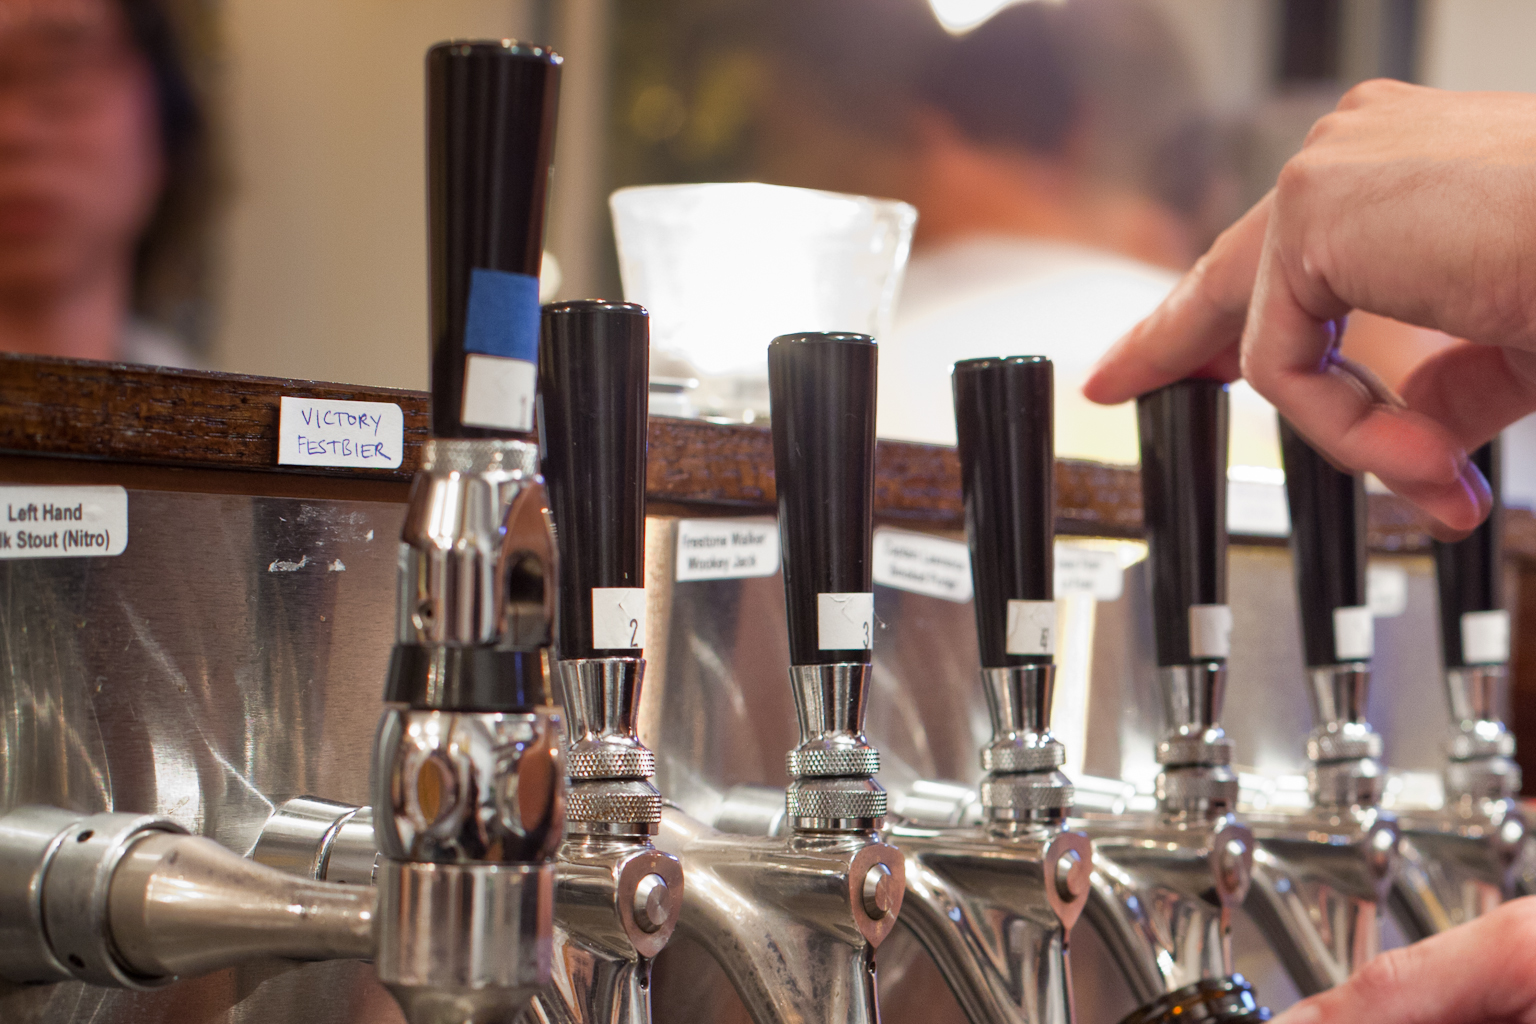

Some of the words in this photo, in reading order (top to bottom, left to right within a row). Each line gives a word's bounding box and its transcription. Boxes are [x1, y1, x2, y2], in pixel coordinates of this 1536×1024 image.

[301, 408, 382, 435] VICTORY
[298, 436, 391, 460] FESTBIER
[8, 503, 38, 521] Left
[43, 503, 82, 521] Hand
[0, 531, 11, 549] lk
[17, 530, 58, 549] Stout
[63, 528, 110, 552] (Nitro)
[629, 618, 639, 648] 2
[862, 621, 870, 648] 3
